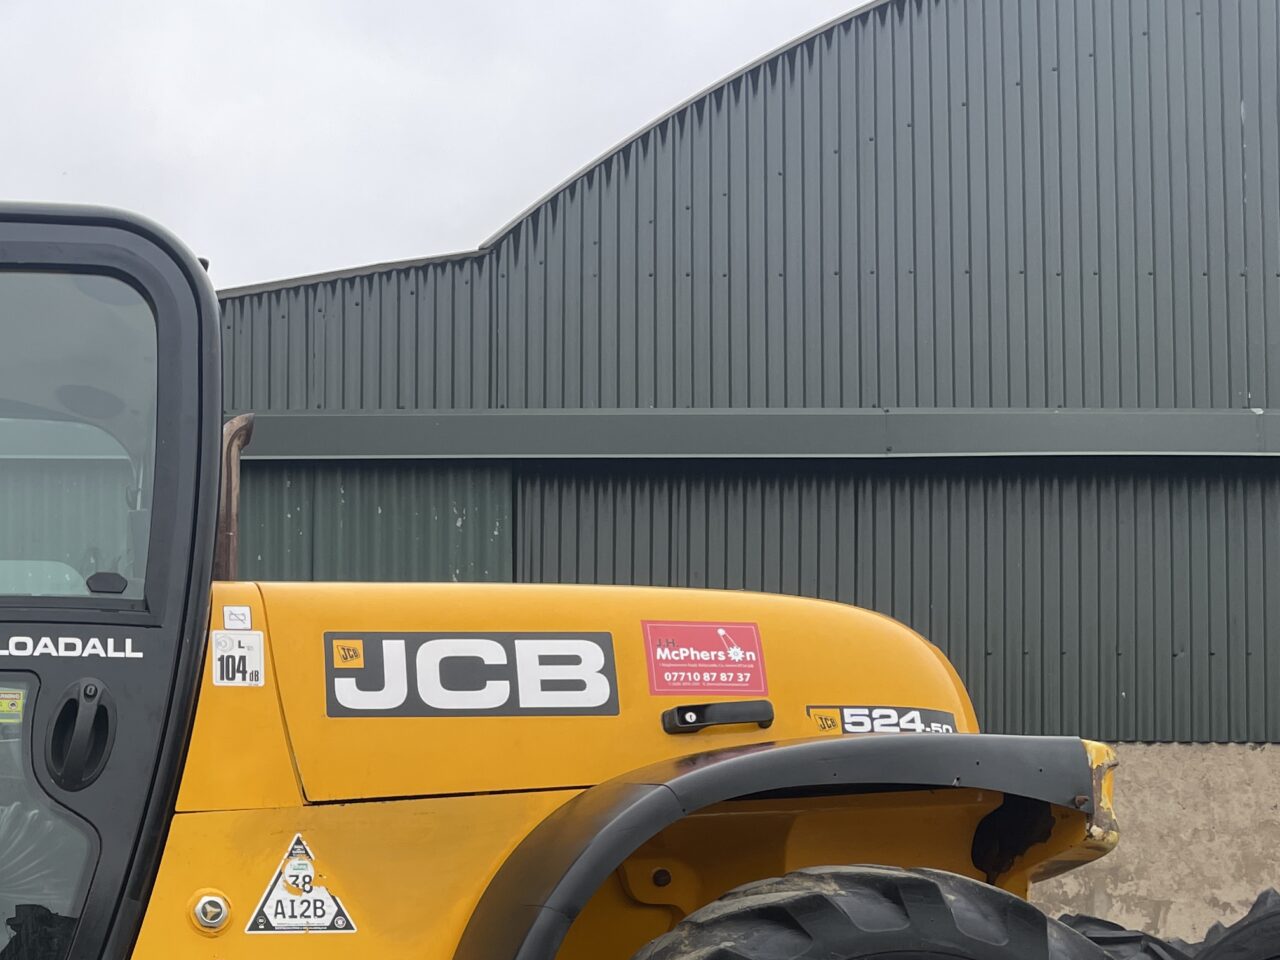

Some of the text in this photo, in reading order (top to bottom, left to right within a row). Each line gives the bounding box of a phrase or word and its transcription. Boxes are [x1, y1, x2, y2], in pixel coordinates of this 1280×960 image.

[340, 646, 360, 661] JCB
[217, 654, 260, 682] 104 dB
[333, 638, 611, 710] JCB
[664, 672, 751, 683] 07710 87 87 37
[819, 716, 837, 730] JCB
